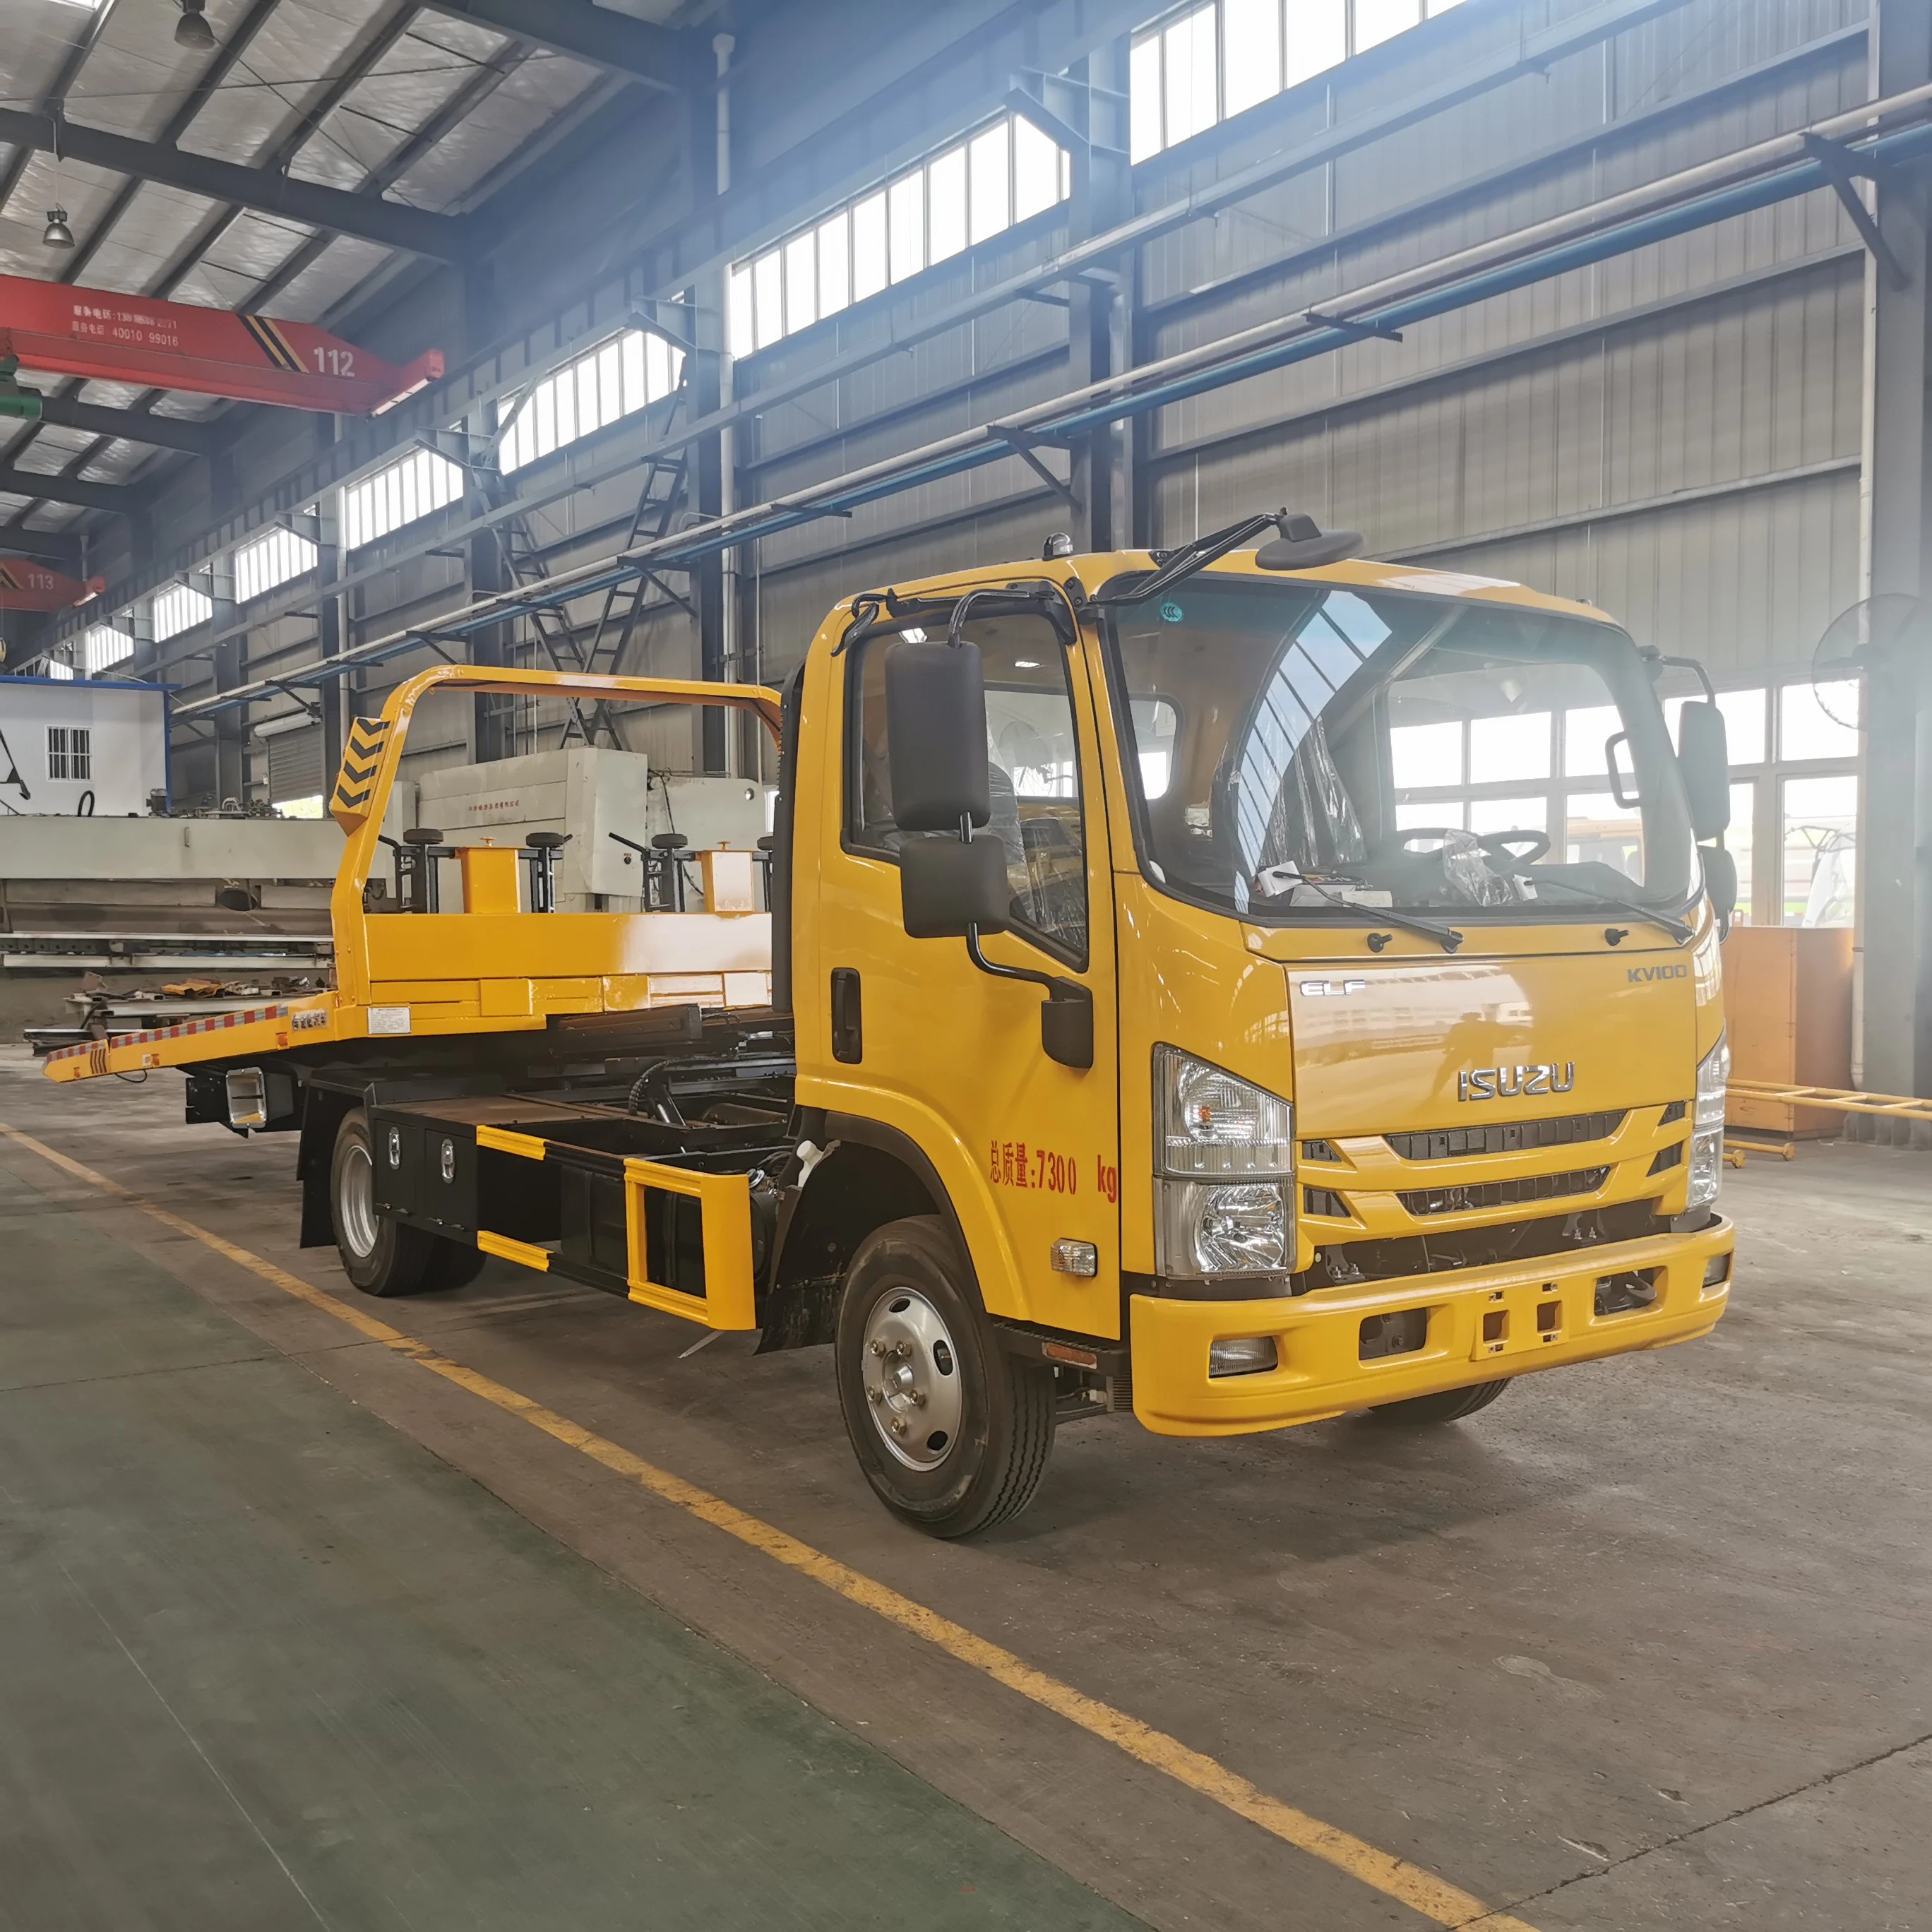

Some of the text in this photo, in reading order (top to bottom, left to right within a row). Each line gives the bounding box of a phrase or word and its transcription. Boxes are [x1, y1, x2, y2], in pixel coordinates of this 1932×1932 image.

[112, 327, 143, 342] 40010
[149, 332, 179, 347] 99016
[314, 347, 355, 377] 112
[28, 573, 54, 590] 113
[1627, 965, 1688, 983] KV100
[1299, 979, 1366, 997] ELF
[1458, 1061, 1575, 1102] ISUZU
[1097, 1155, 1117, 1203] kg
